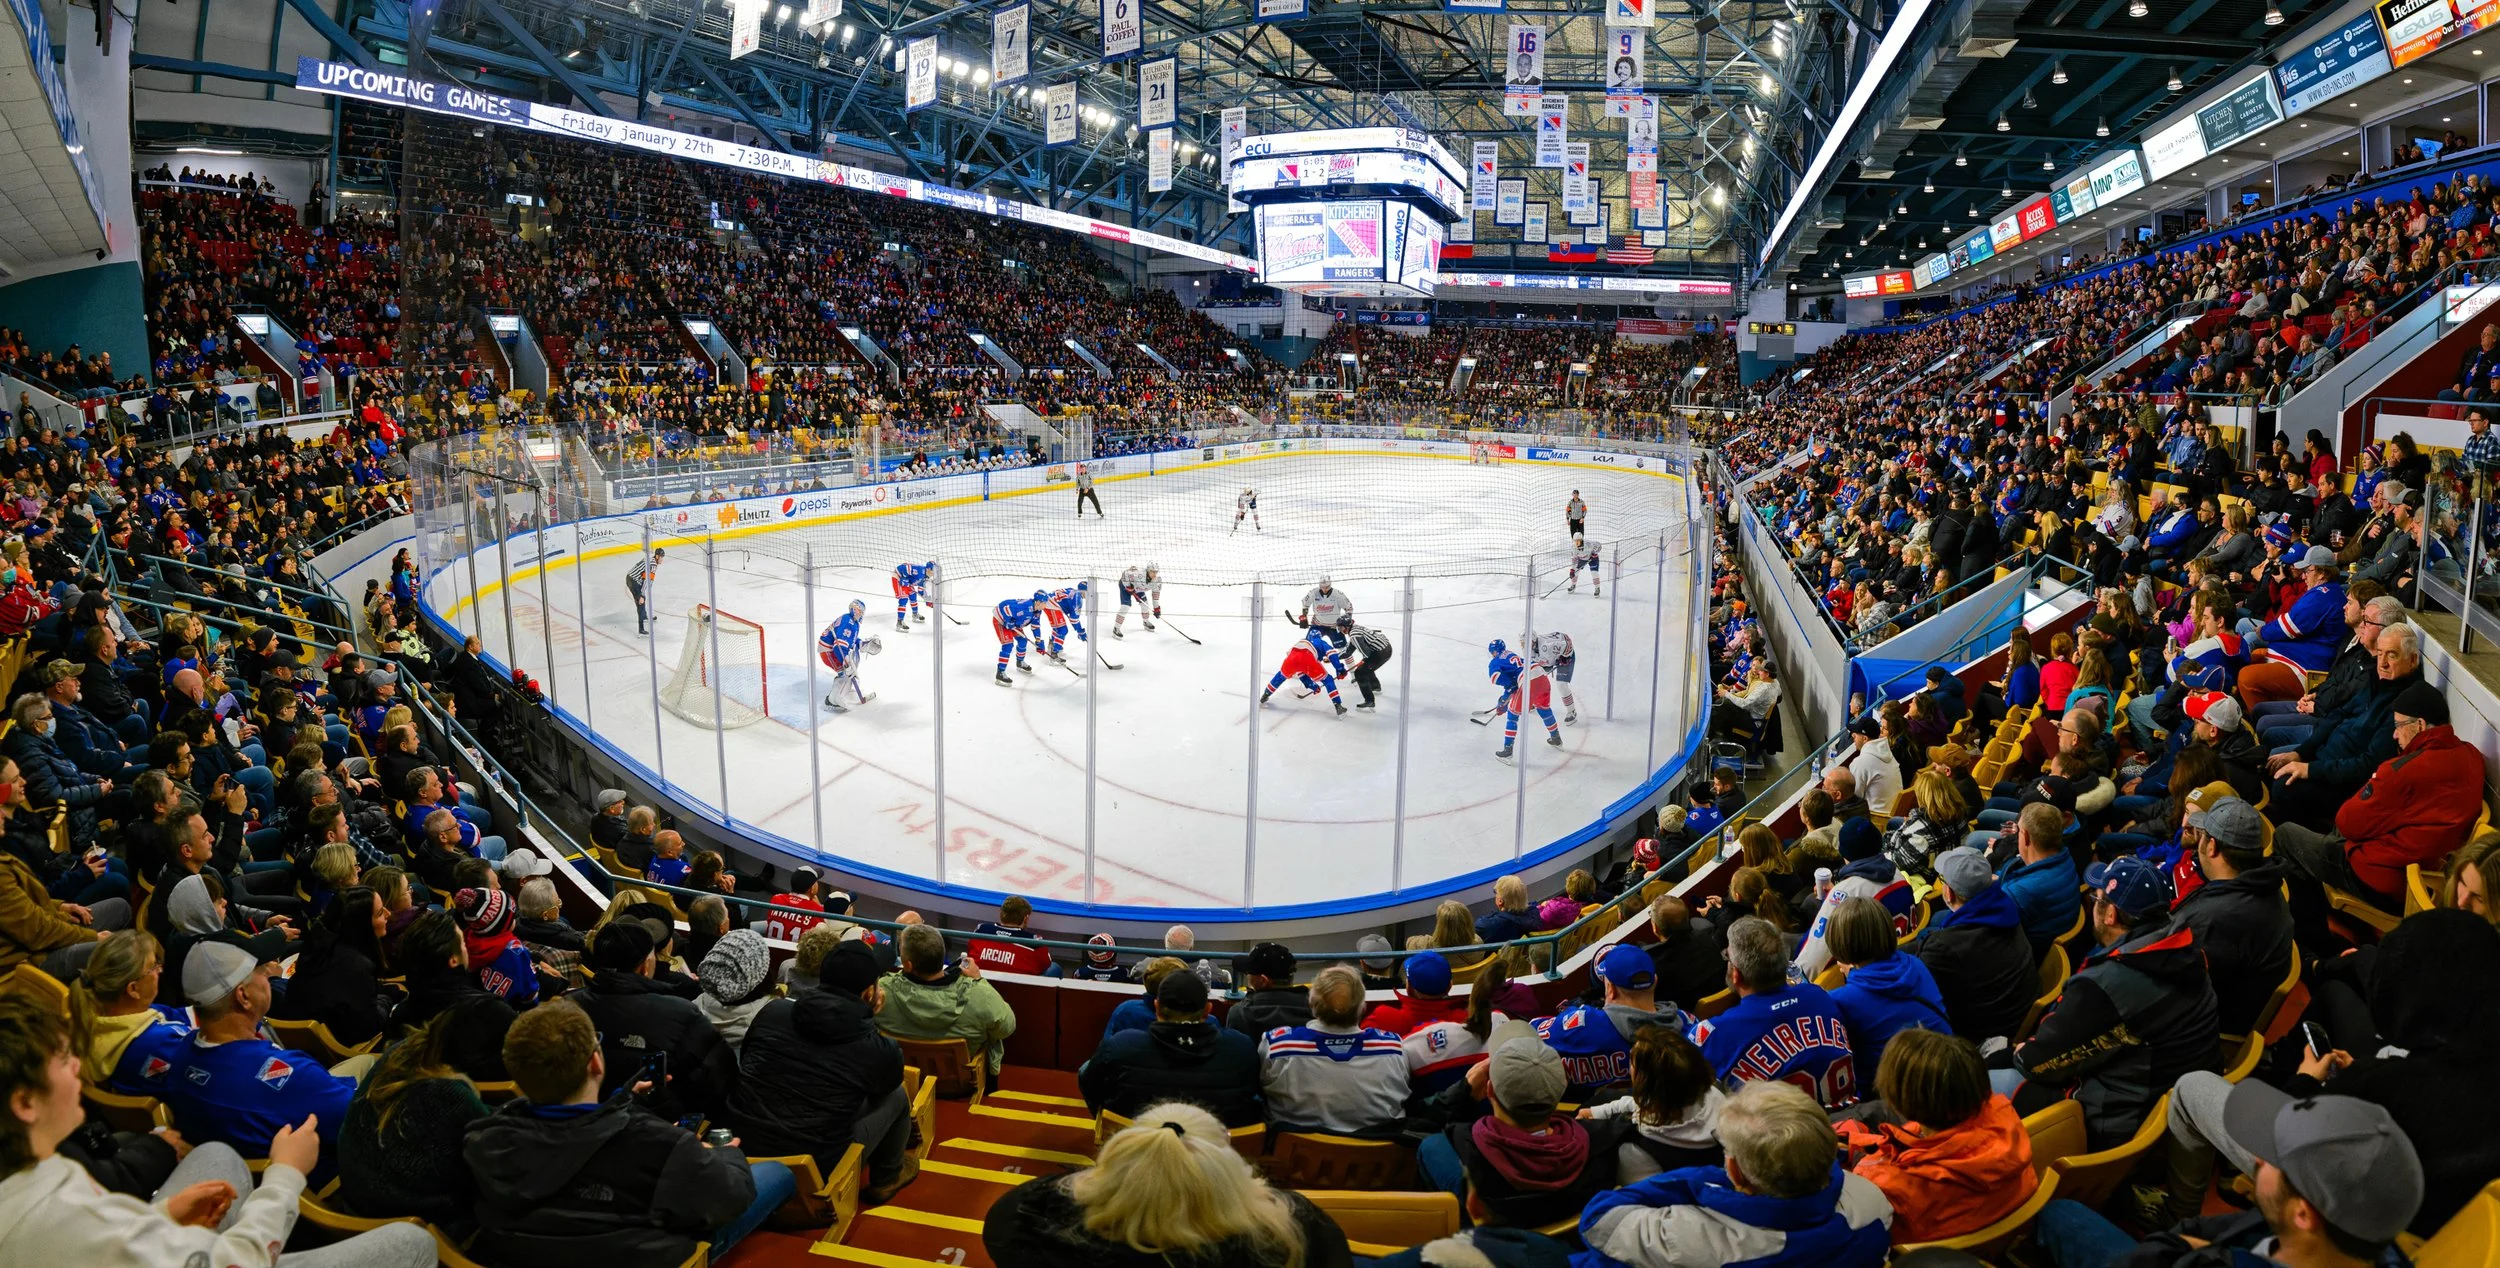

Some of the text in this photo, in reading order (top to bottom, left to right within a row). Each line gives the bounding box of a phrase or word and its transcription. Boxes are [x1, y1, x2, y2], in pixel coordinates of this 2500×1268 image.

[1115, 0, 1128, 20] 6
[1110, 20, 1132, 33] PAUL
[2393, 3, 2498, 57] Partnering With Our Community
[2394, 7, 2444, 41] LEXUS
[1005, 28, 1016, 50] 7
[1106, 27, 1138, 43] COFFEY
[1517, 32, 1537, 53] 16
[1620, 34, 1632, 56] 9
[915, 58, 930, 78] 19
[317, 62, 435, 103] UPCOMING
[2306, 71, 2358, 103] WWW.GO-INS.COM
[1149, 82, 1166, 102] 21
[2240, 102, 2266, 120] CABINETRY
[2244, 97, 2256, 108] FINE
[1053, 103, 1072, 122] 22
[2204, 104, 2233, 127] KITCHEN
[560, 113, 613, 138] friday
[620, 126, 677, 150] january
[684, 138, 714, 155] 27th
[1407, 130, 1426, 141] 50/50
[1245, 143, 1272, 156] ecu
[1303, 157, 1325, 165] 6:05
[876, 173, 908, 188] KITCHENER
[1303, 168, 1325, 178] 1 2
[2093, 174, 2113, 197] MNP
[1273, 215, 1315, 224] GENERALS
[1328, 205, 1377, 219] KITCHENER
[2025, 206, 2045, 225] ACCESS
[1098, 226, 1122, 240] RANGERS
[2027, 216, 2047, 233] STORAGE
[1335, 221, 1372, 260] RANGERS
[1394, 209, 1406, 262] CityNews
[1334, 268, 1375, 278] RANGERS
[1358, 314, 1412, 323] pepsi pepsi
[1535, 450, 1570, 460] WINMAR
[1047, 464, 1065, 476] NEXT
[907, 488, 937, 500] graphics
[799, 495, 832, 514] pepsi
[840, 498, 873, 511] Payworks
[578, 527, 616, 546] Radisson
[979, 947, 1016, 966] ARCURI
[1770, 997, 1799, 1011] CCM
[1323, 1037, 1356, 1046] CCM
